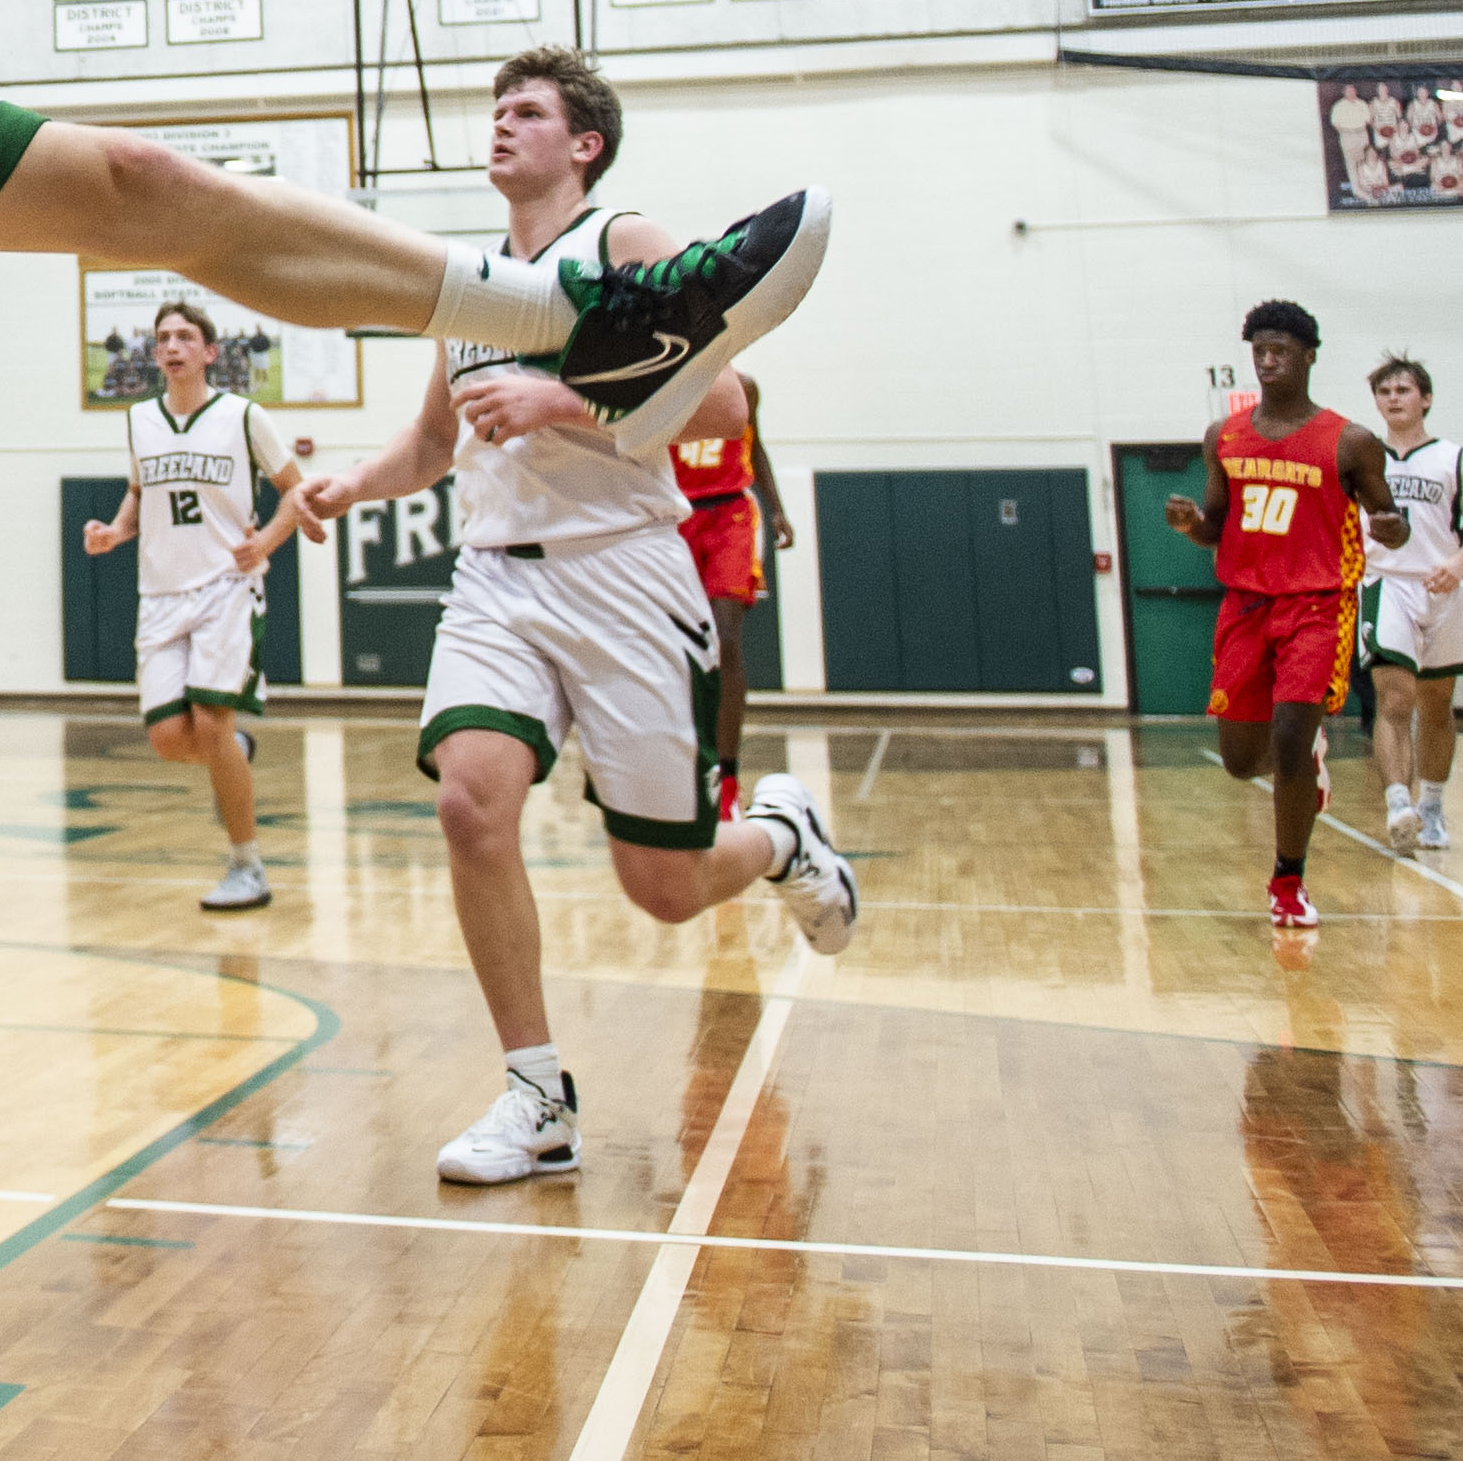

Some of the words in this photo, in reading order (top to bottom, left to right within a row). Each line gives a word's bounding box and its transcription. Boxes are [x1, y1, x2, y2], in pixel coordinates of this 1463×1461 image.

[67, 6, 132, 20] DISTRICT
[179, 0, 245, 14] DISTRICT
[79, 22, 122, 32] CHAMPS
[192, 15, 236, 25] CHAMPS
[95, 291, 155, 299] SOFTBALL
[1207, 365, 1234, 388] 13
[679, 438, 723, 469] 42
[140, 452, 233, 486] FREELAND
[1222, 458, 1322, 488] BEARCATS
[169, 490, 203, 526] 12
[1240, 484, 1298, 535] 30
